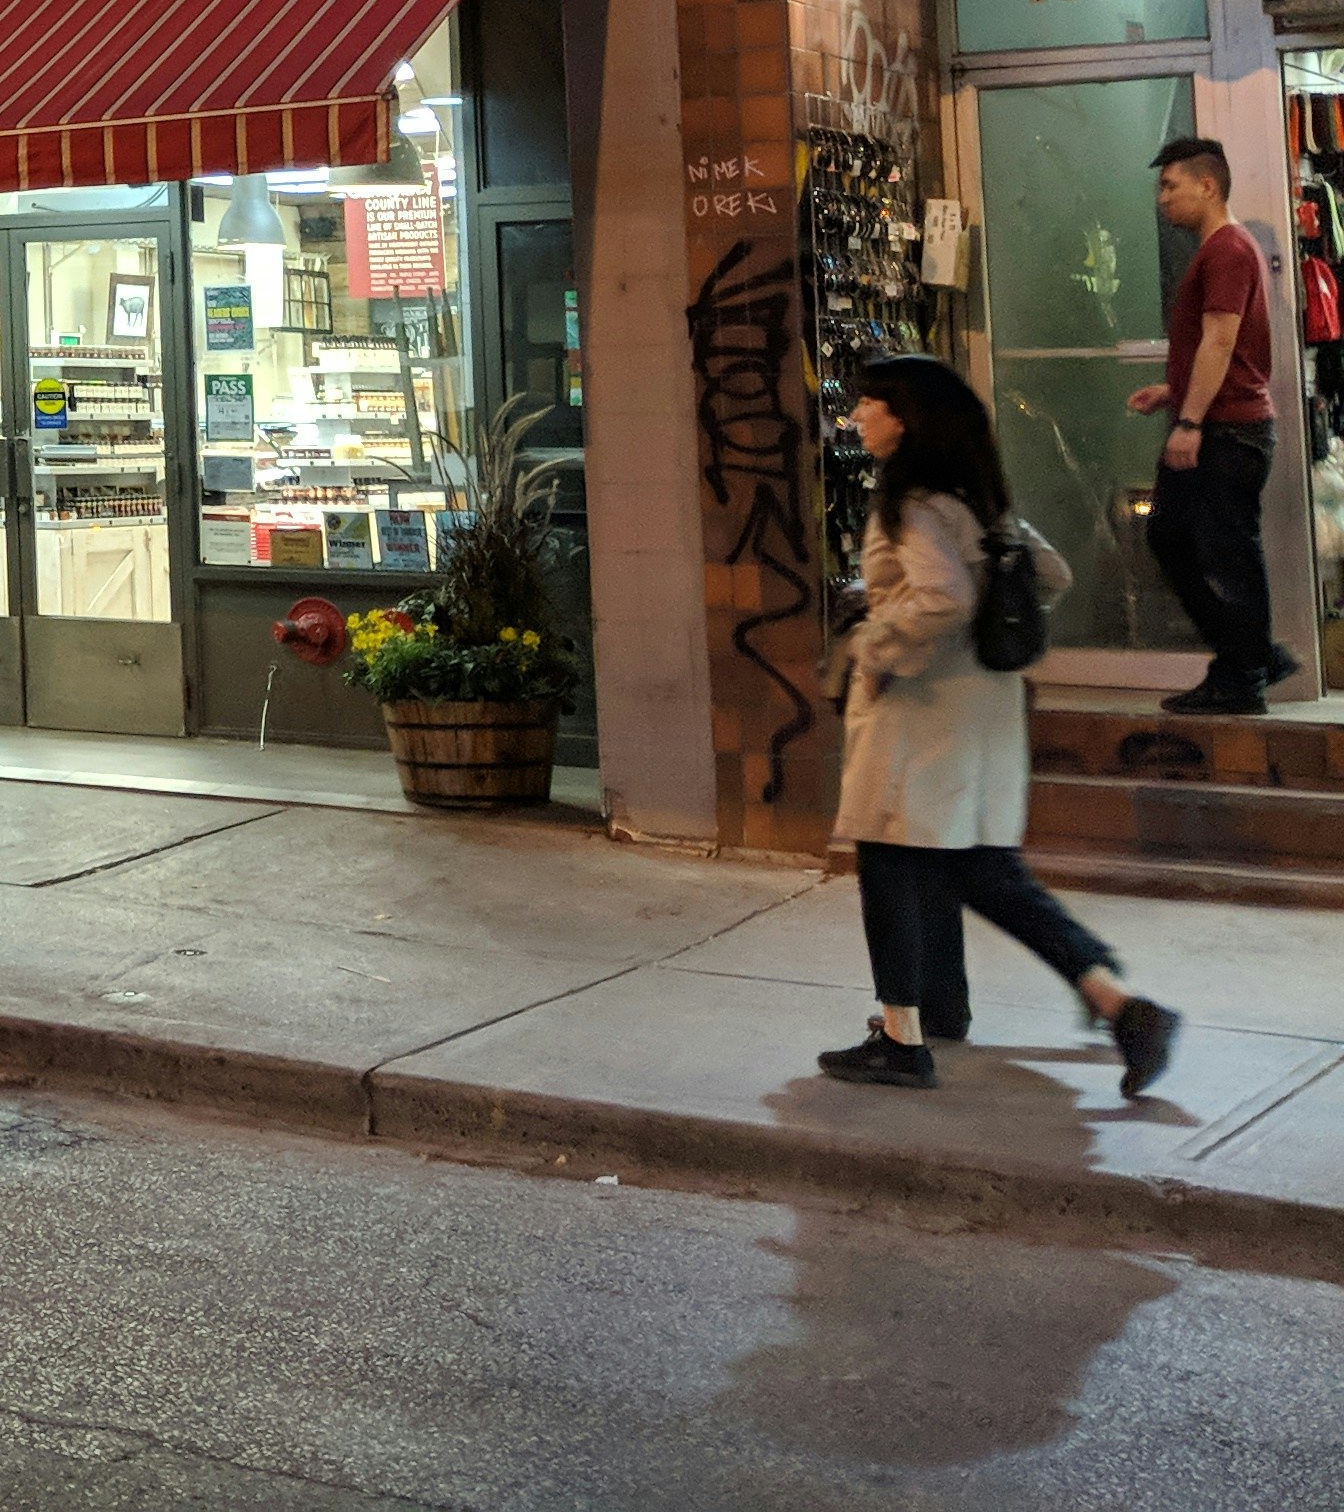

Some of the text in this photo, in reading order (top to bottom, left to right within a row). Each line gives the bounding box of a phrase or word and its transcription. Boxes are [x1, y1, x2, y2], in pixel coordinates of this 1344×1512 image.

[365, 196, 437, 210] COUNTY LINE
[367, 209, 437, 222] IS OUR PREMIUM
[399, 230, 439, 240] PRODUCTS
[212, 380, 246, 396] PASS
[328, 539, 366, 548] Winner
